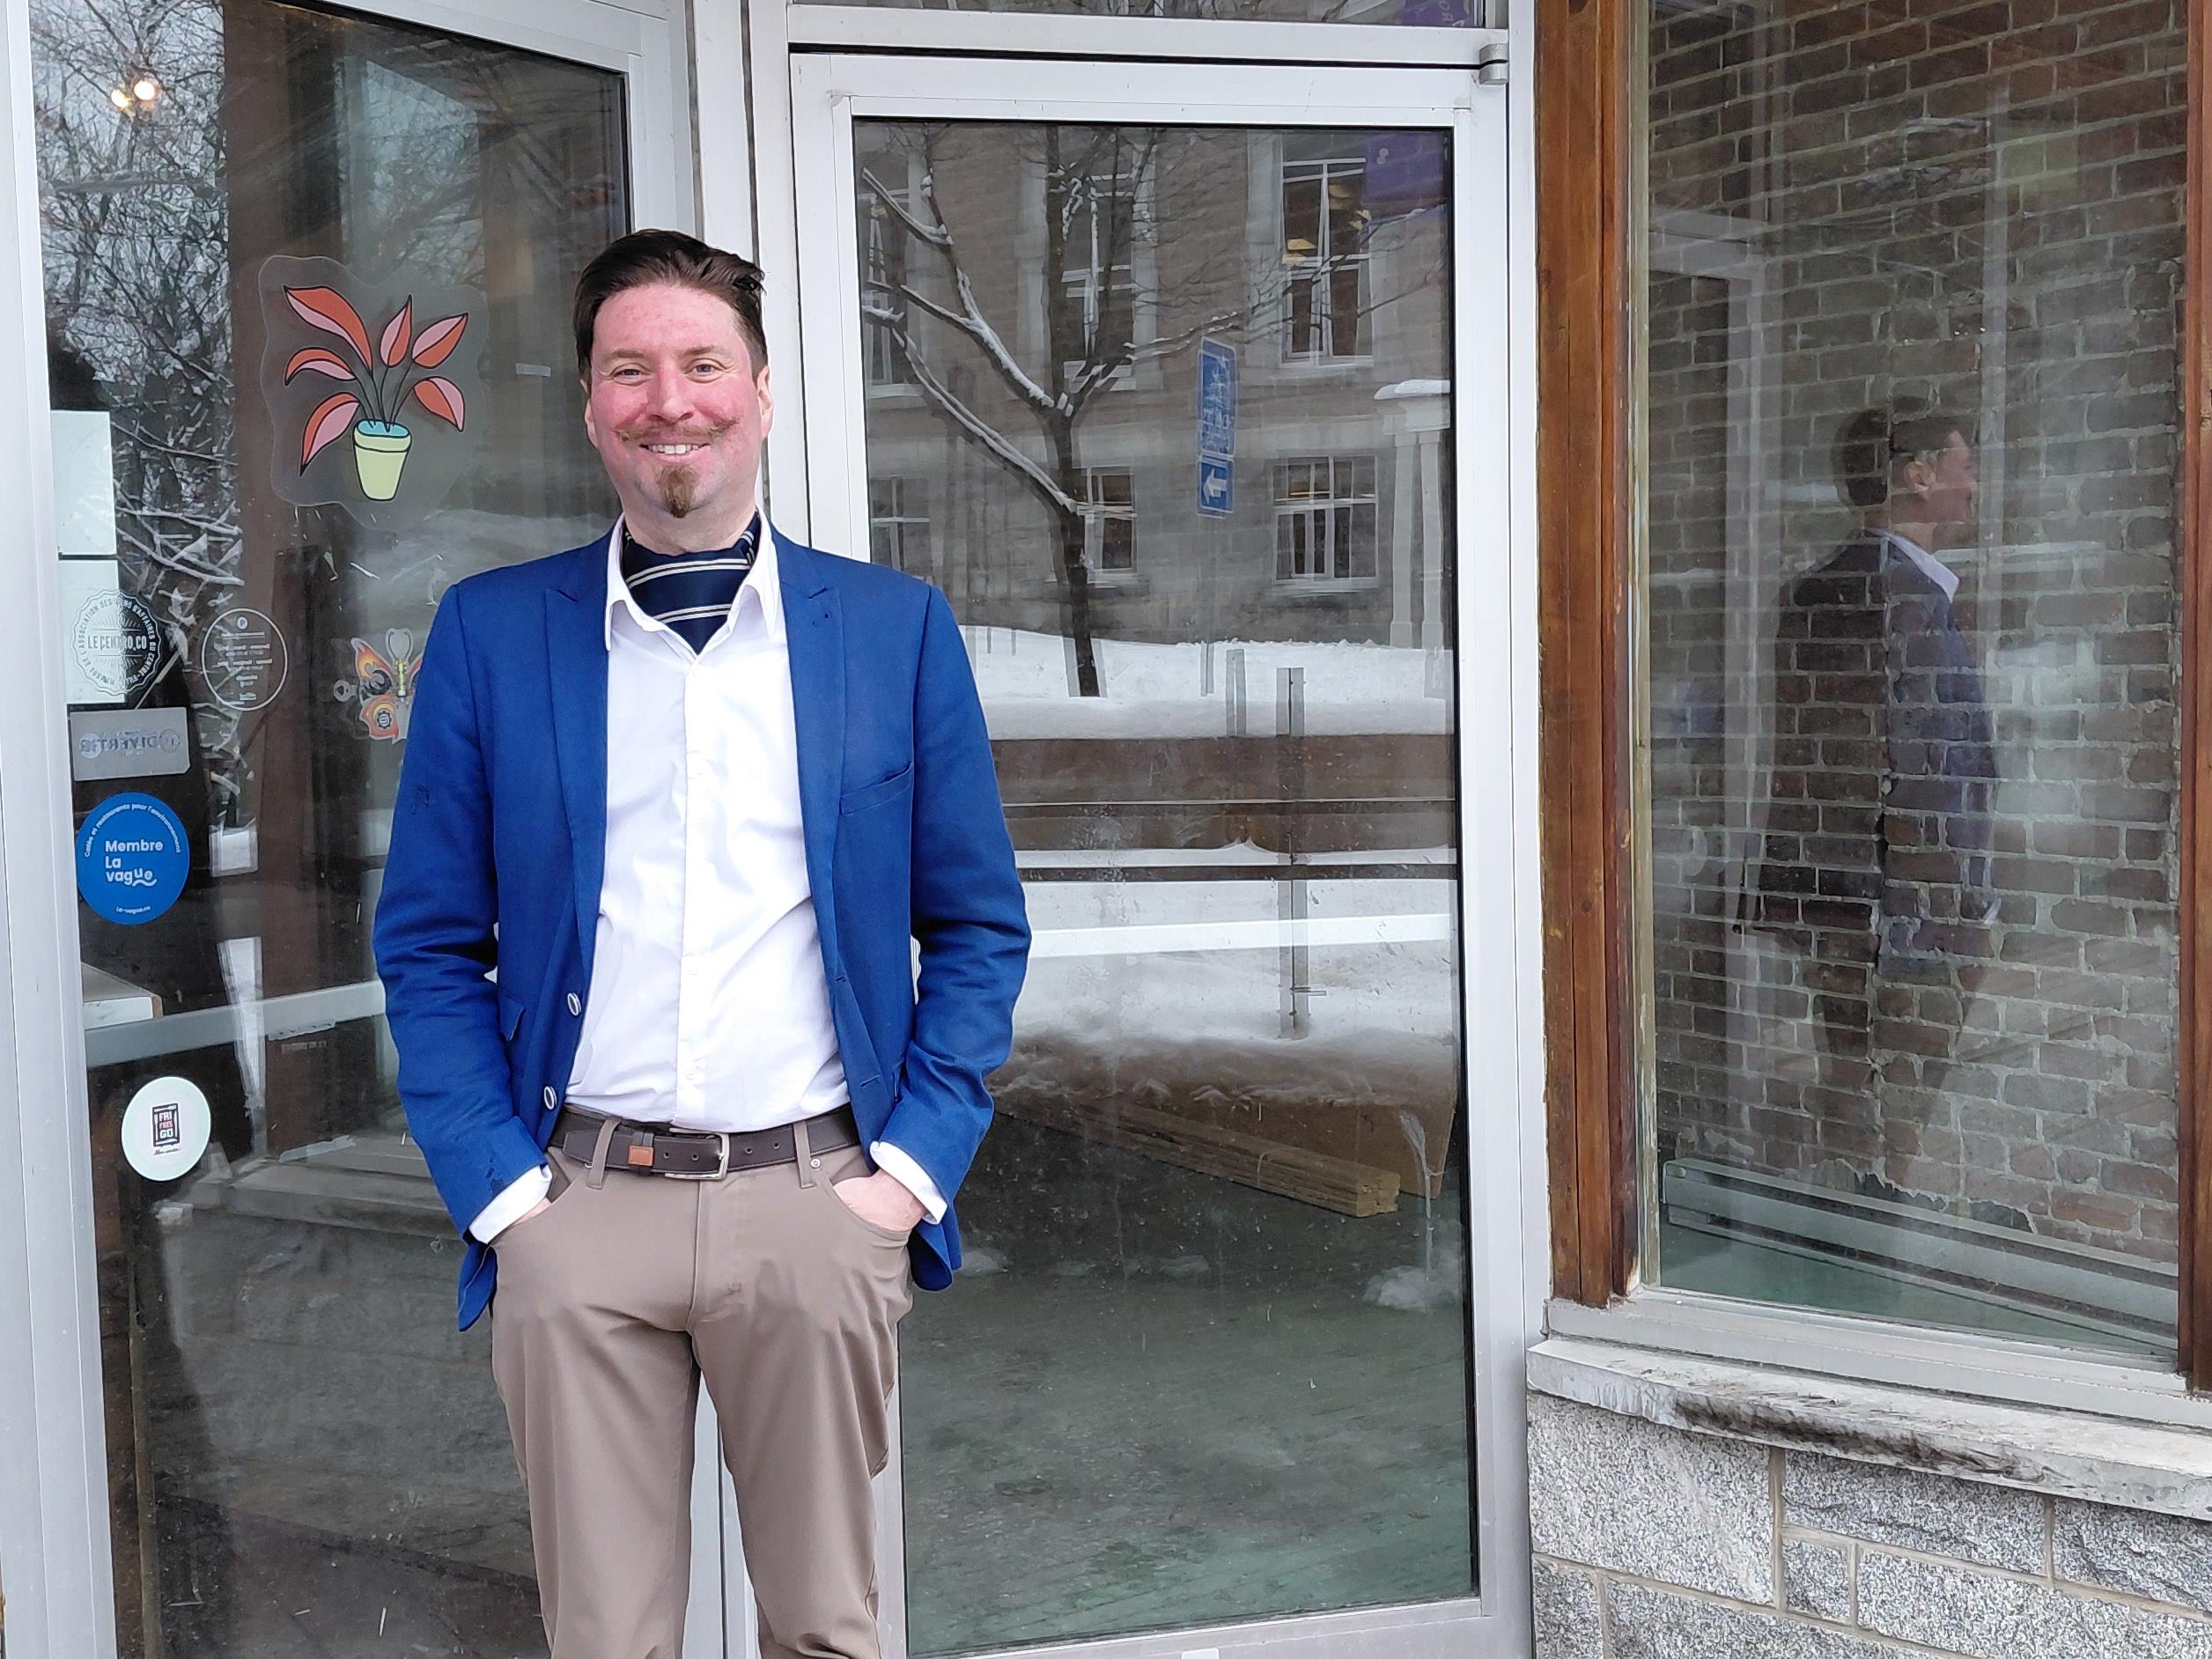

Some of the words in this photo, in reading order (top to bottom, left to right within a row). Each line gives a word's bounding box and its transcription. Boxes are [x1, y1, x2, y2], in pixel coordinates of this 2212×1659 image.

[99, 599, 113, 608] DES
[131, 604, 155, 639] D'AFFAIRES
[149, 641, 157, 652] DU
[106, 839, 164, 852] Membre
[105, 856, 122, 868] La
[106, 868, 153, 885] vague
[159, 1110, 173, 1121] FRI
[159, 1128, 173, 1139] GO
